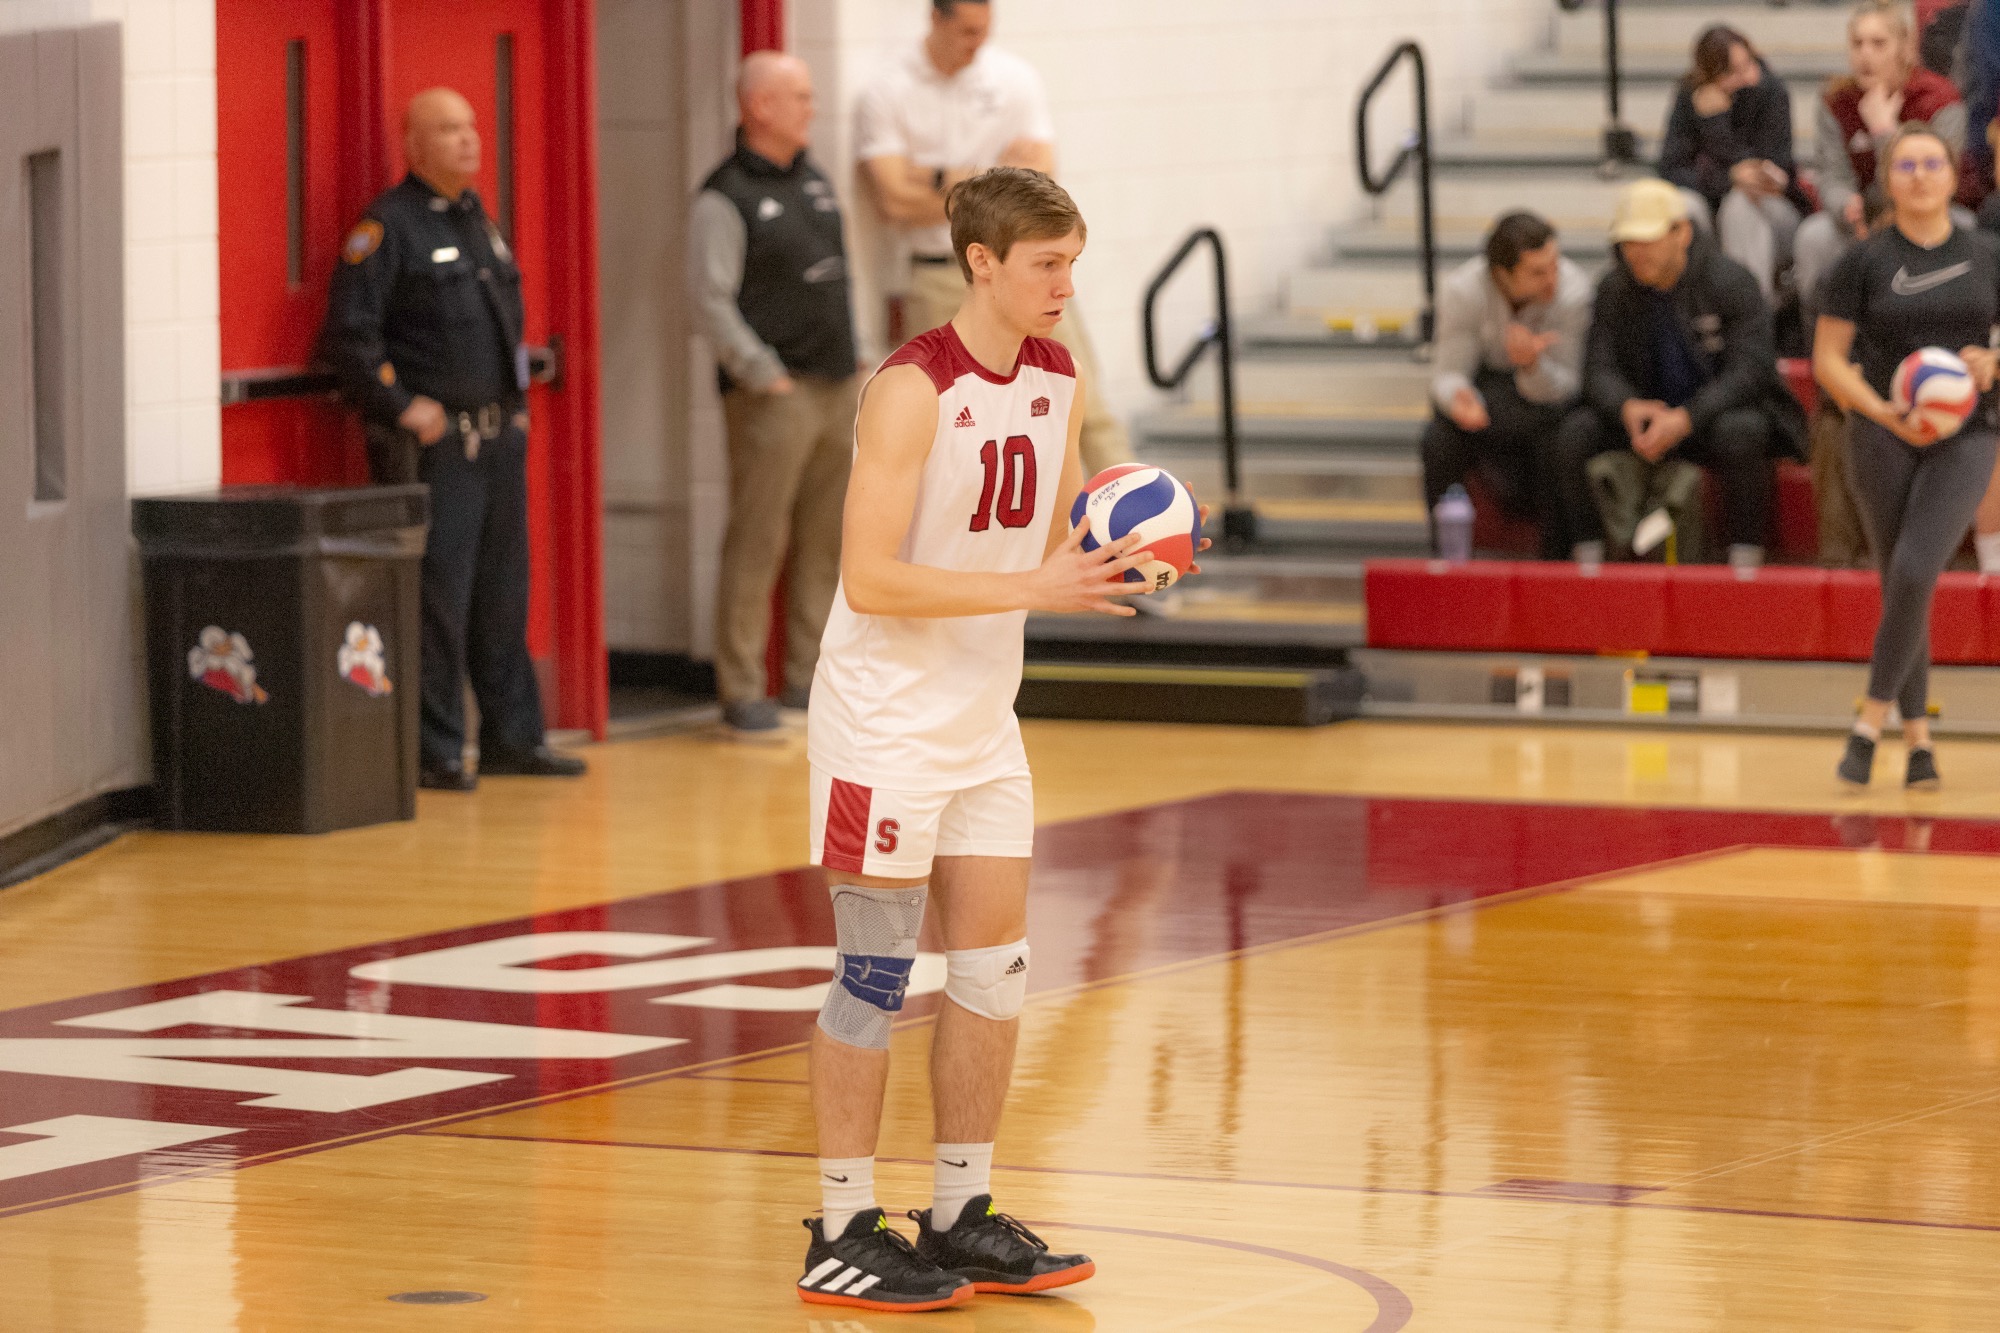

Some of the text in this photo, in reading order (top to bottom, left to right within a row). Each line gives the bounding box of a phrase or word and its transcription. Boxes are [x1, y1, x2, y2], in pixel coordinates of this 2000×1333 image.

[954, 419, 976, 428] adidas
[969, 434, 1037, 532] 10
[1091, 480, 1120, 507] STEVENS
[874, 817, 900, 854] S
